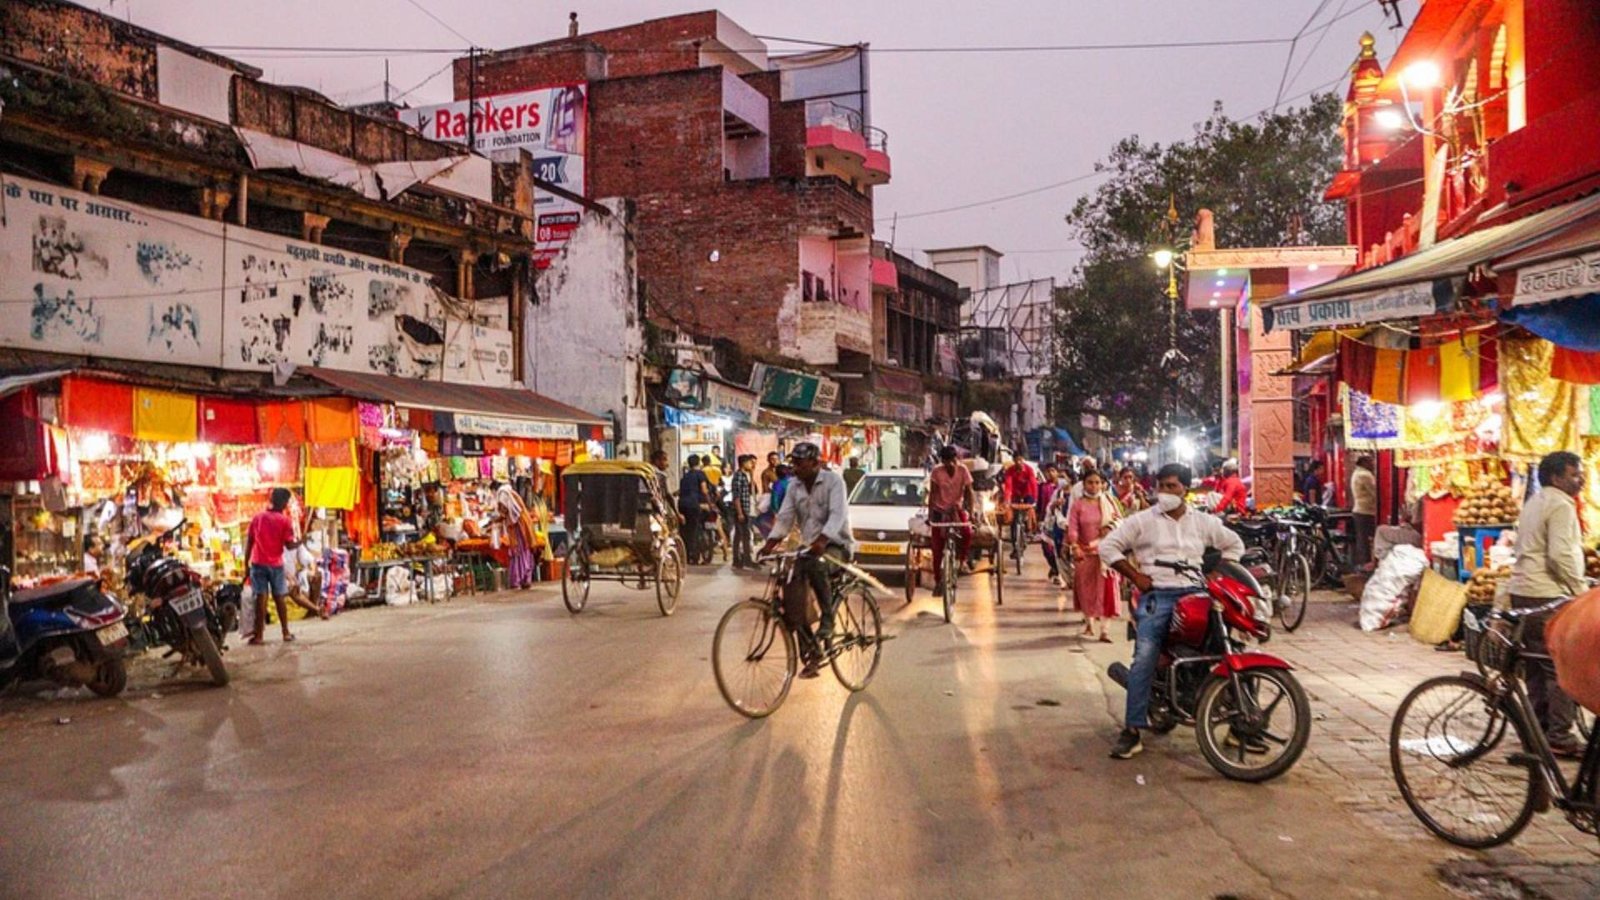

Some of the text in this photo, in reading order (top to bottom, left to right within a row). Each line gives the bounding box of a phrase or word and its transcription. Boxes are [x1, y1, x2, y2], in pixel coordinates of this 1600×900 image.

[435, 101, 541, 139] Rankers
[493, 132, 541, 147] FOUNDATION
[60, 196, 79, 211] पर
[1275, 306, 1300, 326] सत्य
[1308, 301, 1351, 321] प्रकाश
